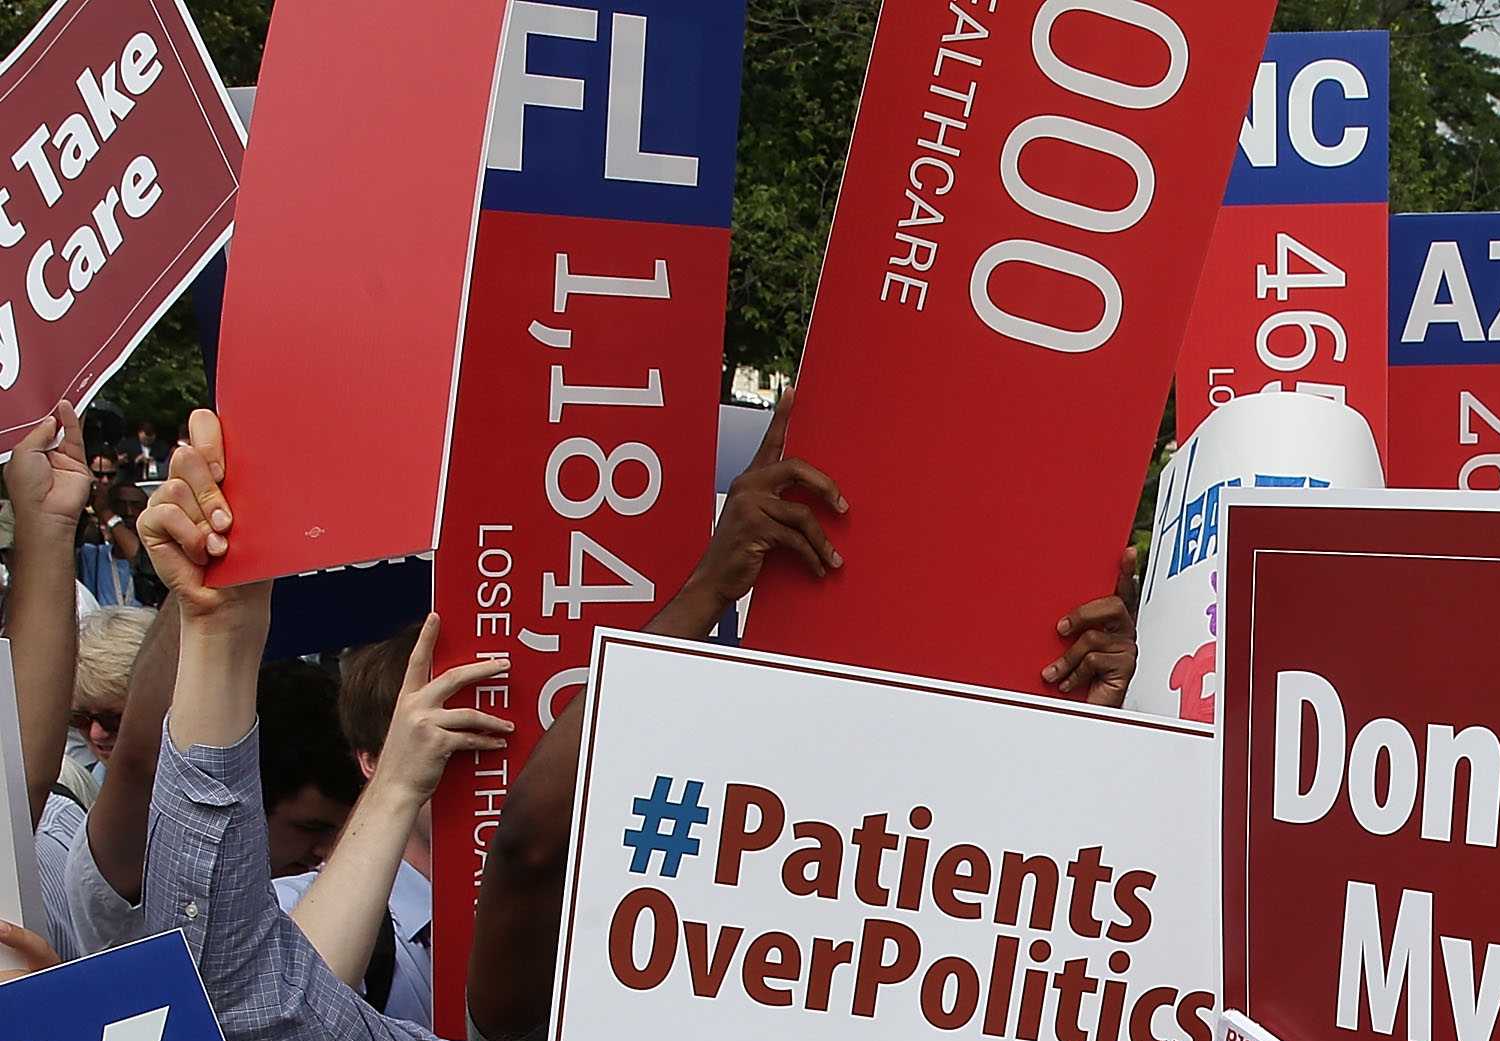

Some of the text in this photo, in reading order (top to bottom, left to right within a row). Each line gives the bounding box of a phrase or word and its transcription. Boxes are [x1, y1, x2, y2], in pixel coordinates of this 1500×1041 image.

[11, 32, 163, 207] Take
[487, 0, 699, 187] FL
[26, 155, 163, 322] Care
[475, 525, 513, 637] LOSE
[622, 774, 1158, 944] #Patients
